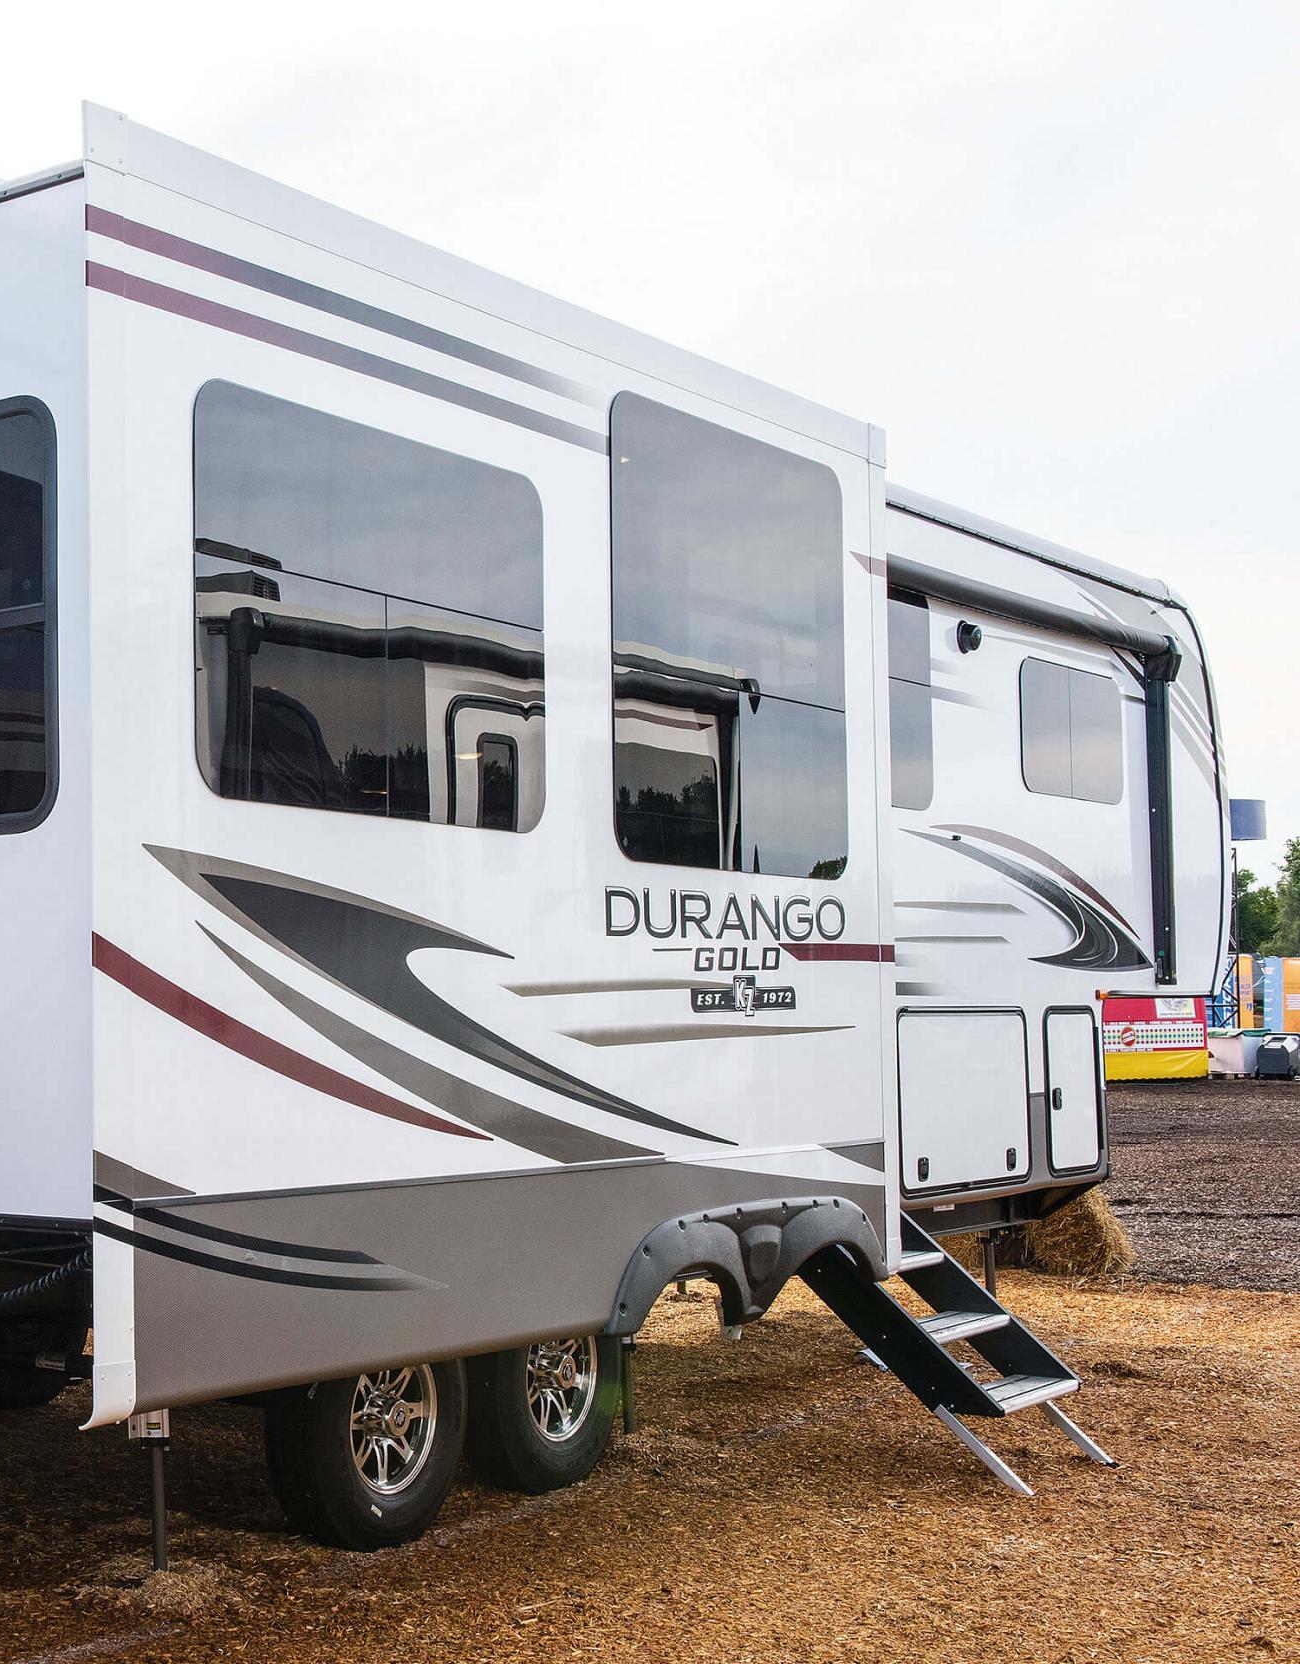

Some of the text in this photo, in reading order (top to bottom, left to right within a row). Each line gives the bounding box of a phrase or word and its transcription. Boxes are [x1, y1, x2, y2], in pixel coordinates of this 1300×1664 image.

[605, 886, 846, 941] DURANGO
[694, 947, 781, 971] GOLD
[697, 978, 793, 1017] EST. KZ 1972
